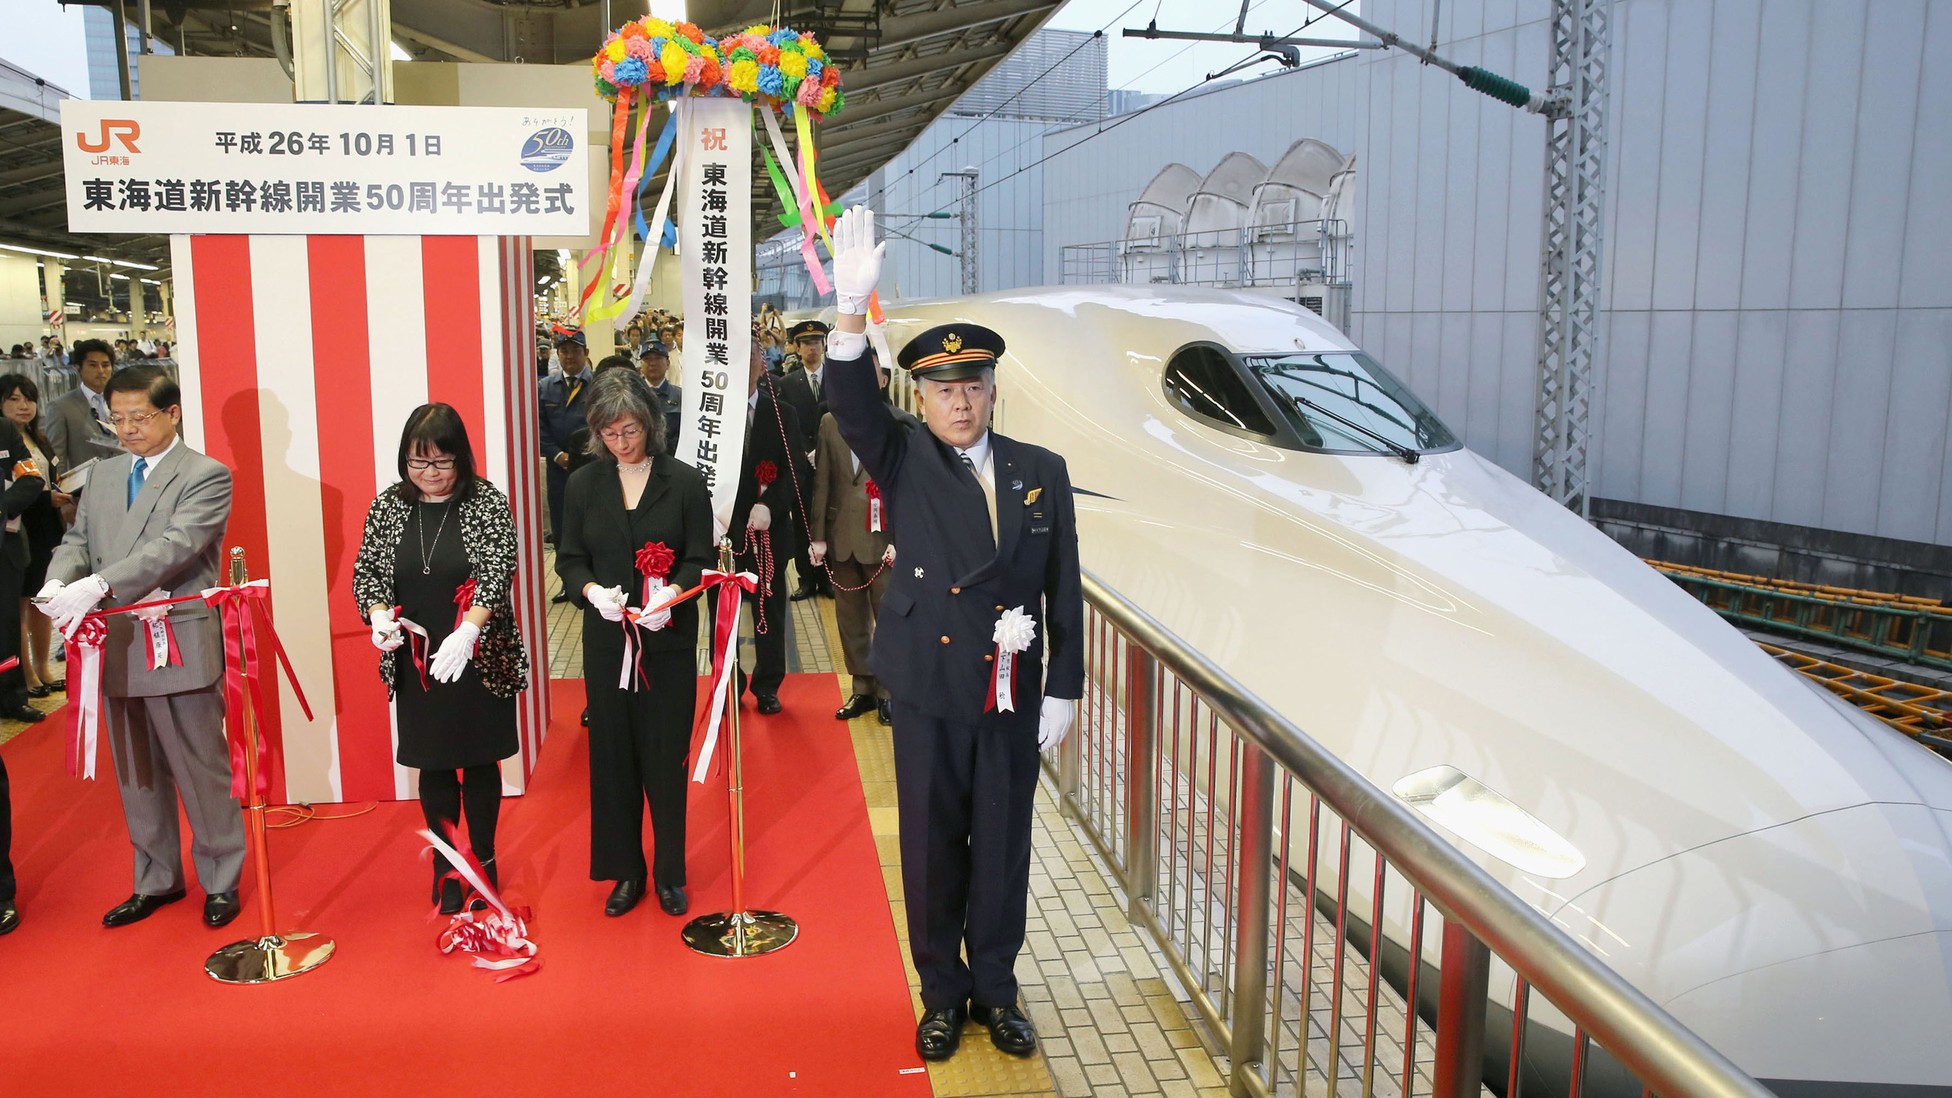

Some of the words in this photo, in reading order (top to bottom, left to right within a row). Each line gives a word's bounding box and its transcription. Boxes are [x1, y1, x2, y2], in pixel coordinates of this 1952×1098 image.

[77, 119, 142, 154] JR
[701, 127, 728, 151] 祝
[91, 155, 130, 166] JR東海
[82, 178, 575, 216] 東海道新幹線開業50周年出発式
[696, 162, 729, 498] 東海道新幹線開業50周年出発
